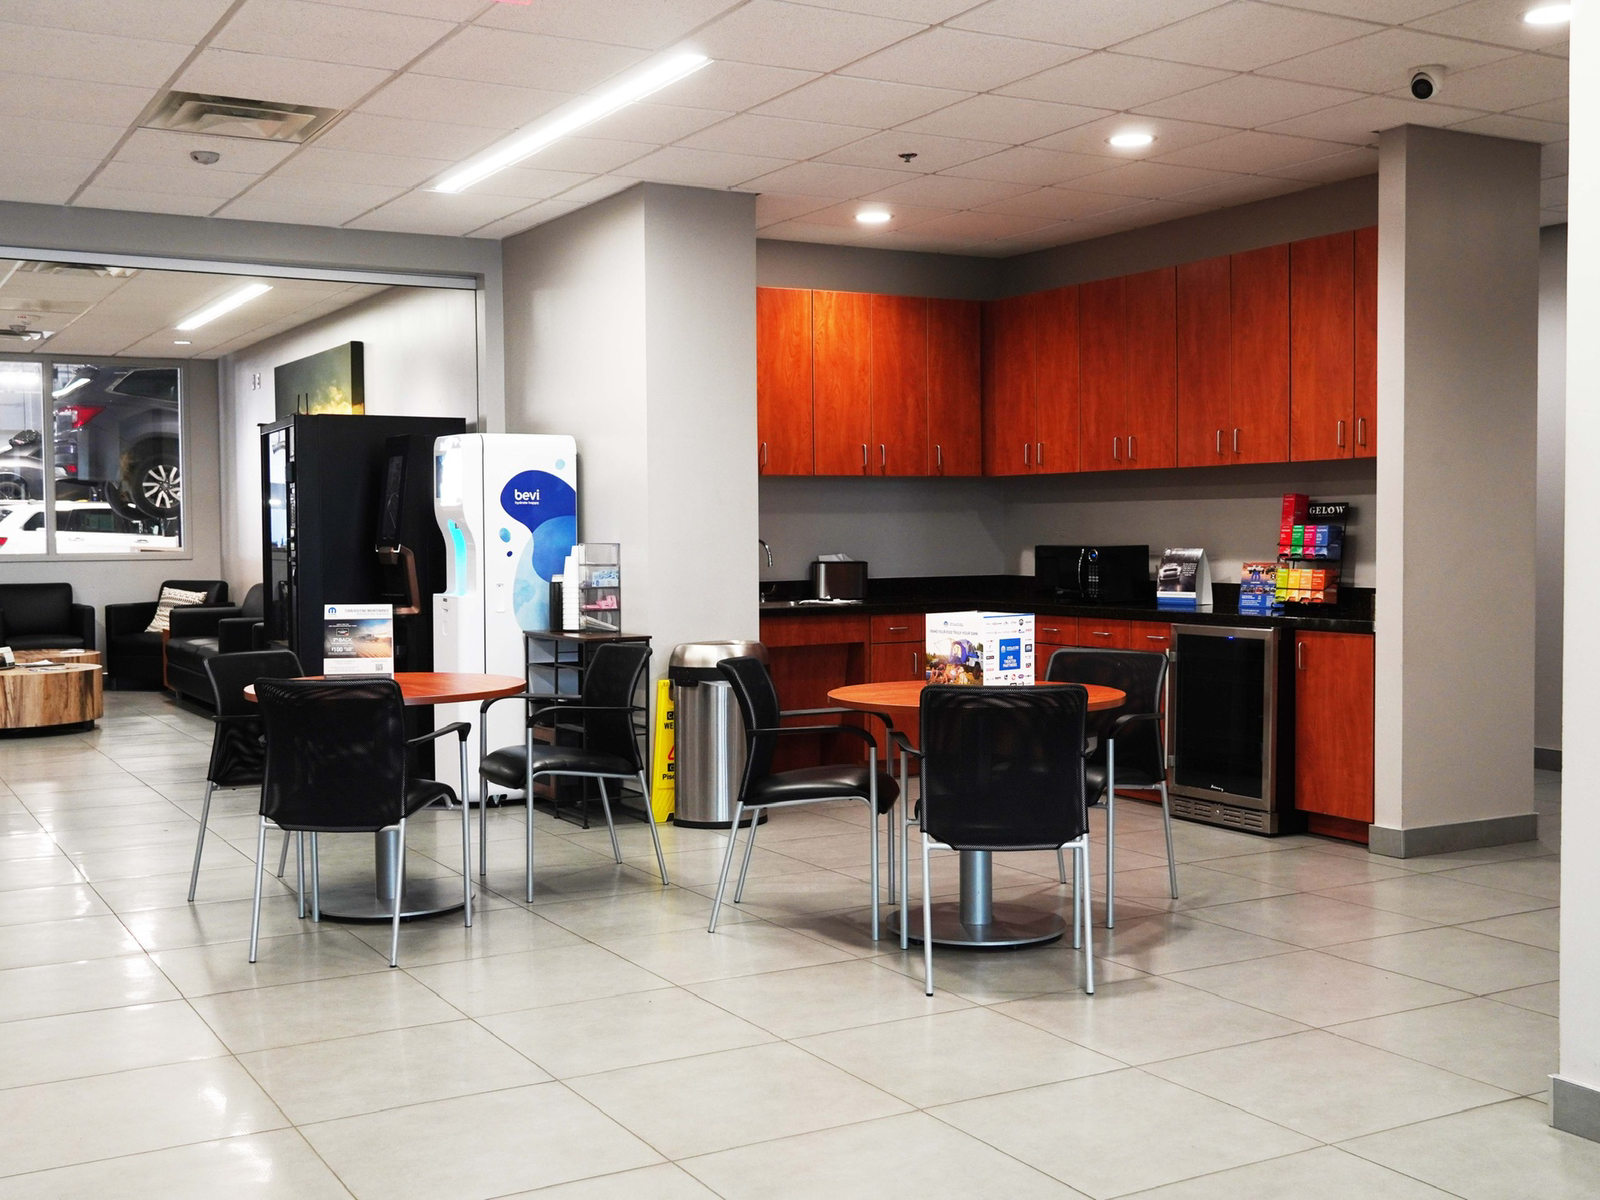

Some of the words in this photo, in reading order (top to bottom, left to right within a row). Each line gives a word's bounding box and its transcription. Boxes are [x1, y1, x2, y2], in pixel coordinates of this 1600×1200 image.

[514, 488, 540, 501] bevi
[1309, 505, 1346, 515] GELOW
[664, 722, 674, 730] WE
